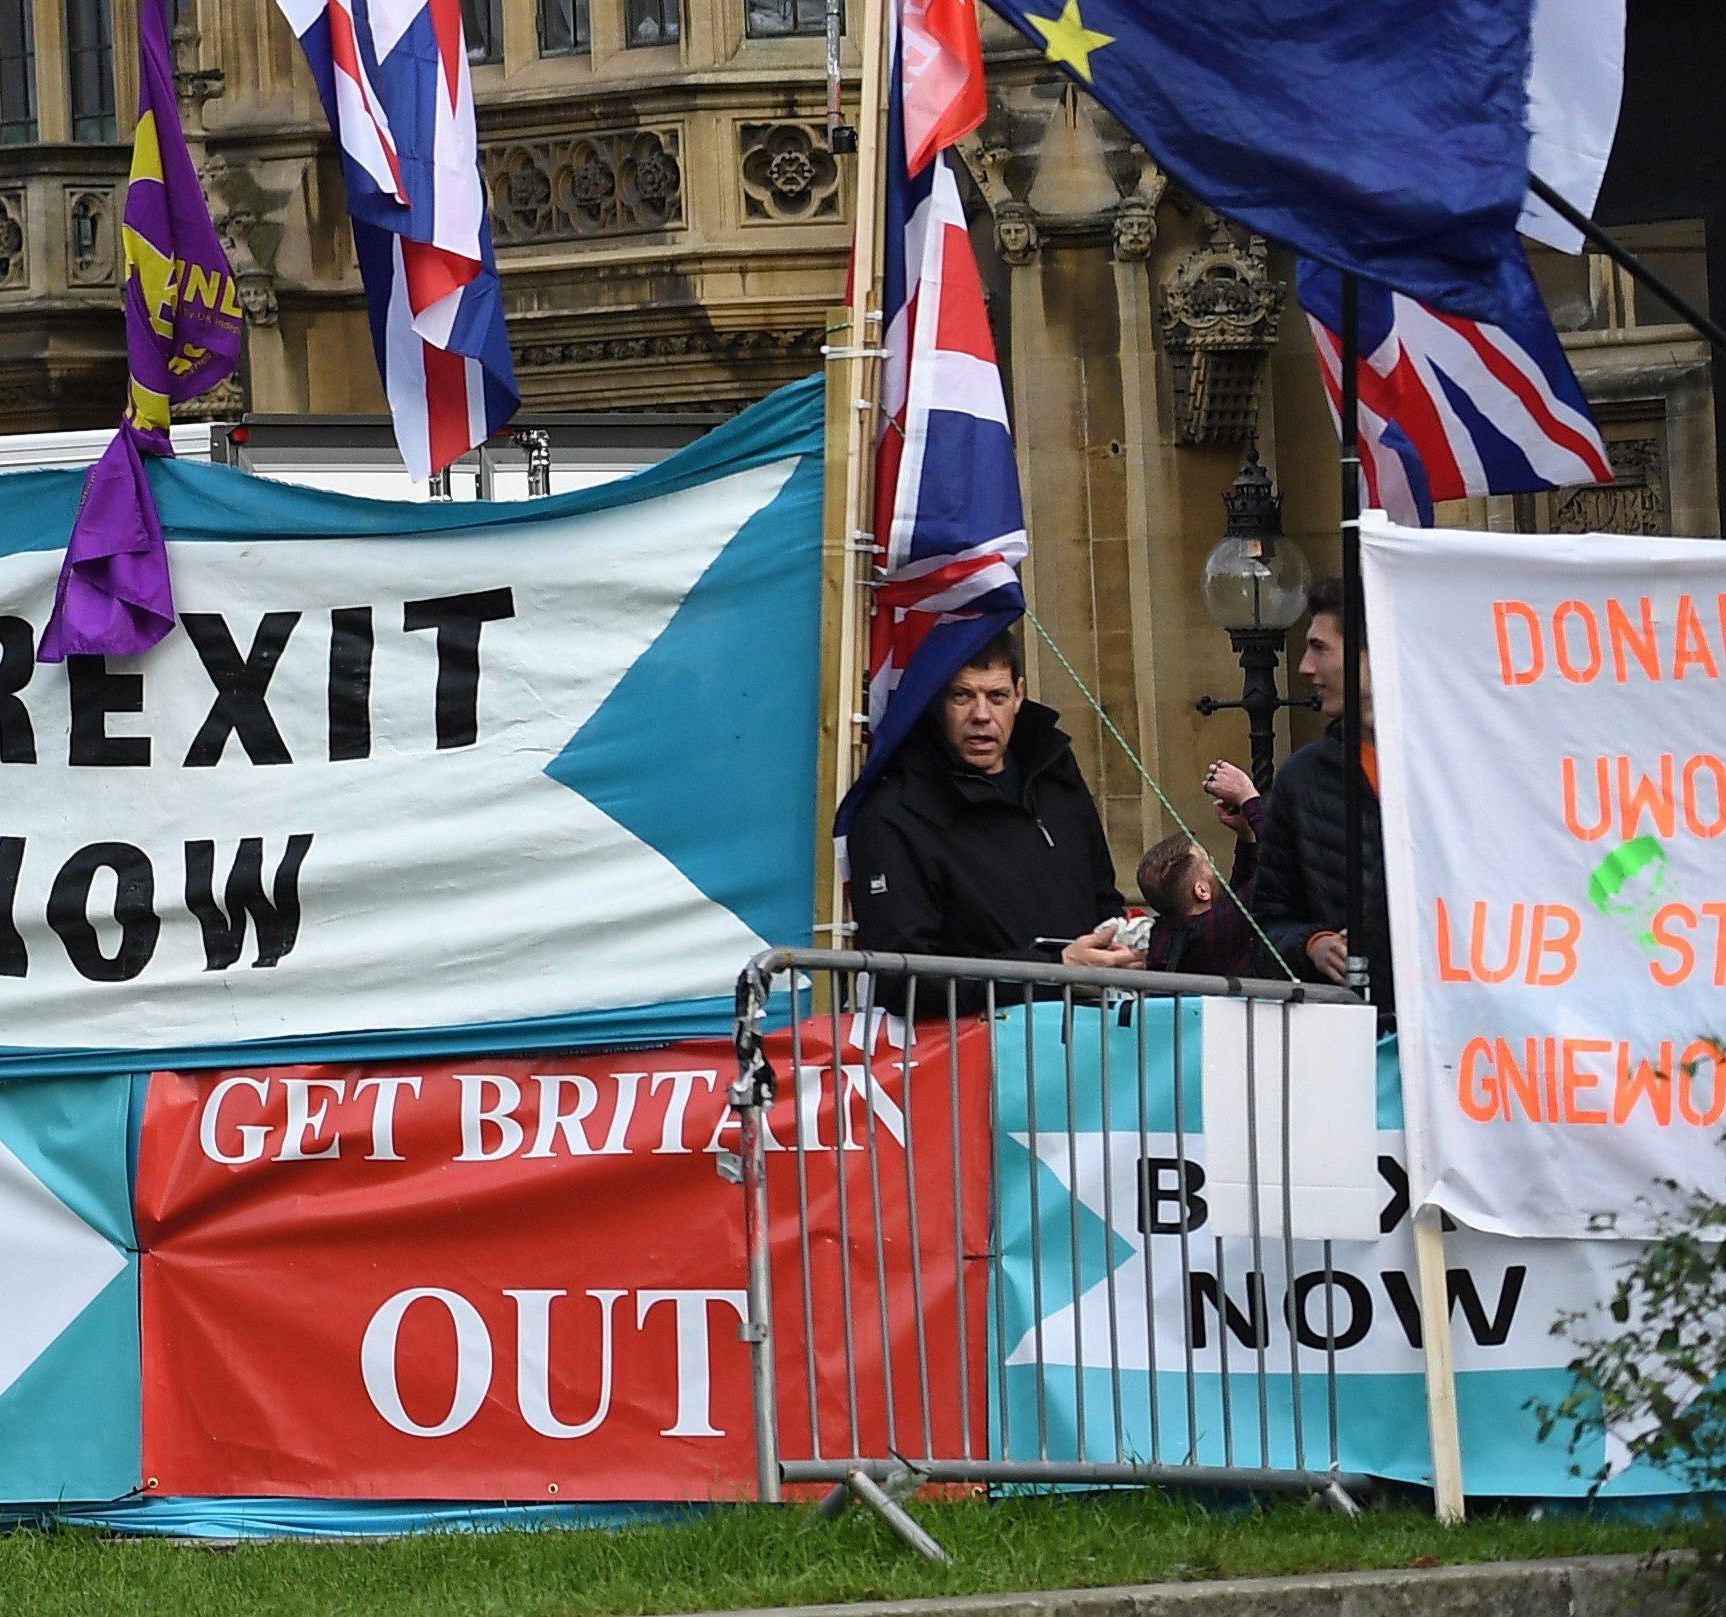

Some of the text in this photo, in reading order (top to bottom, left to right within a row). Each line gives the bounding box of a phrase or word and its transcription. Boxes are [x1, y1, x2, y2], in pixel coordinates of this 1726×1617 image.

[1493, 593, 1726, 686] DONA
[1435, 897, 1582, 984] LUB
[199, 1076, 422, 1164] GET
[1457, 1034, 1726, 1127] GNIEWO
[1185, 1265, 1527, 1350] NOW
[360, 1286, 749, 1438] OUT
